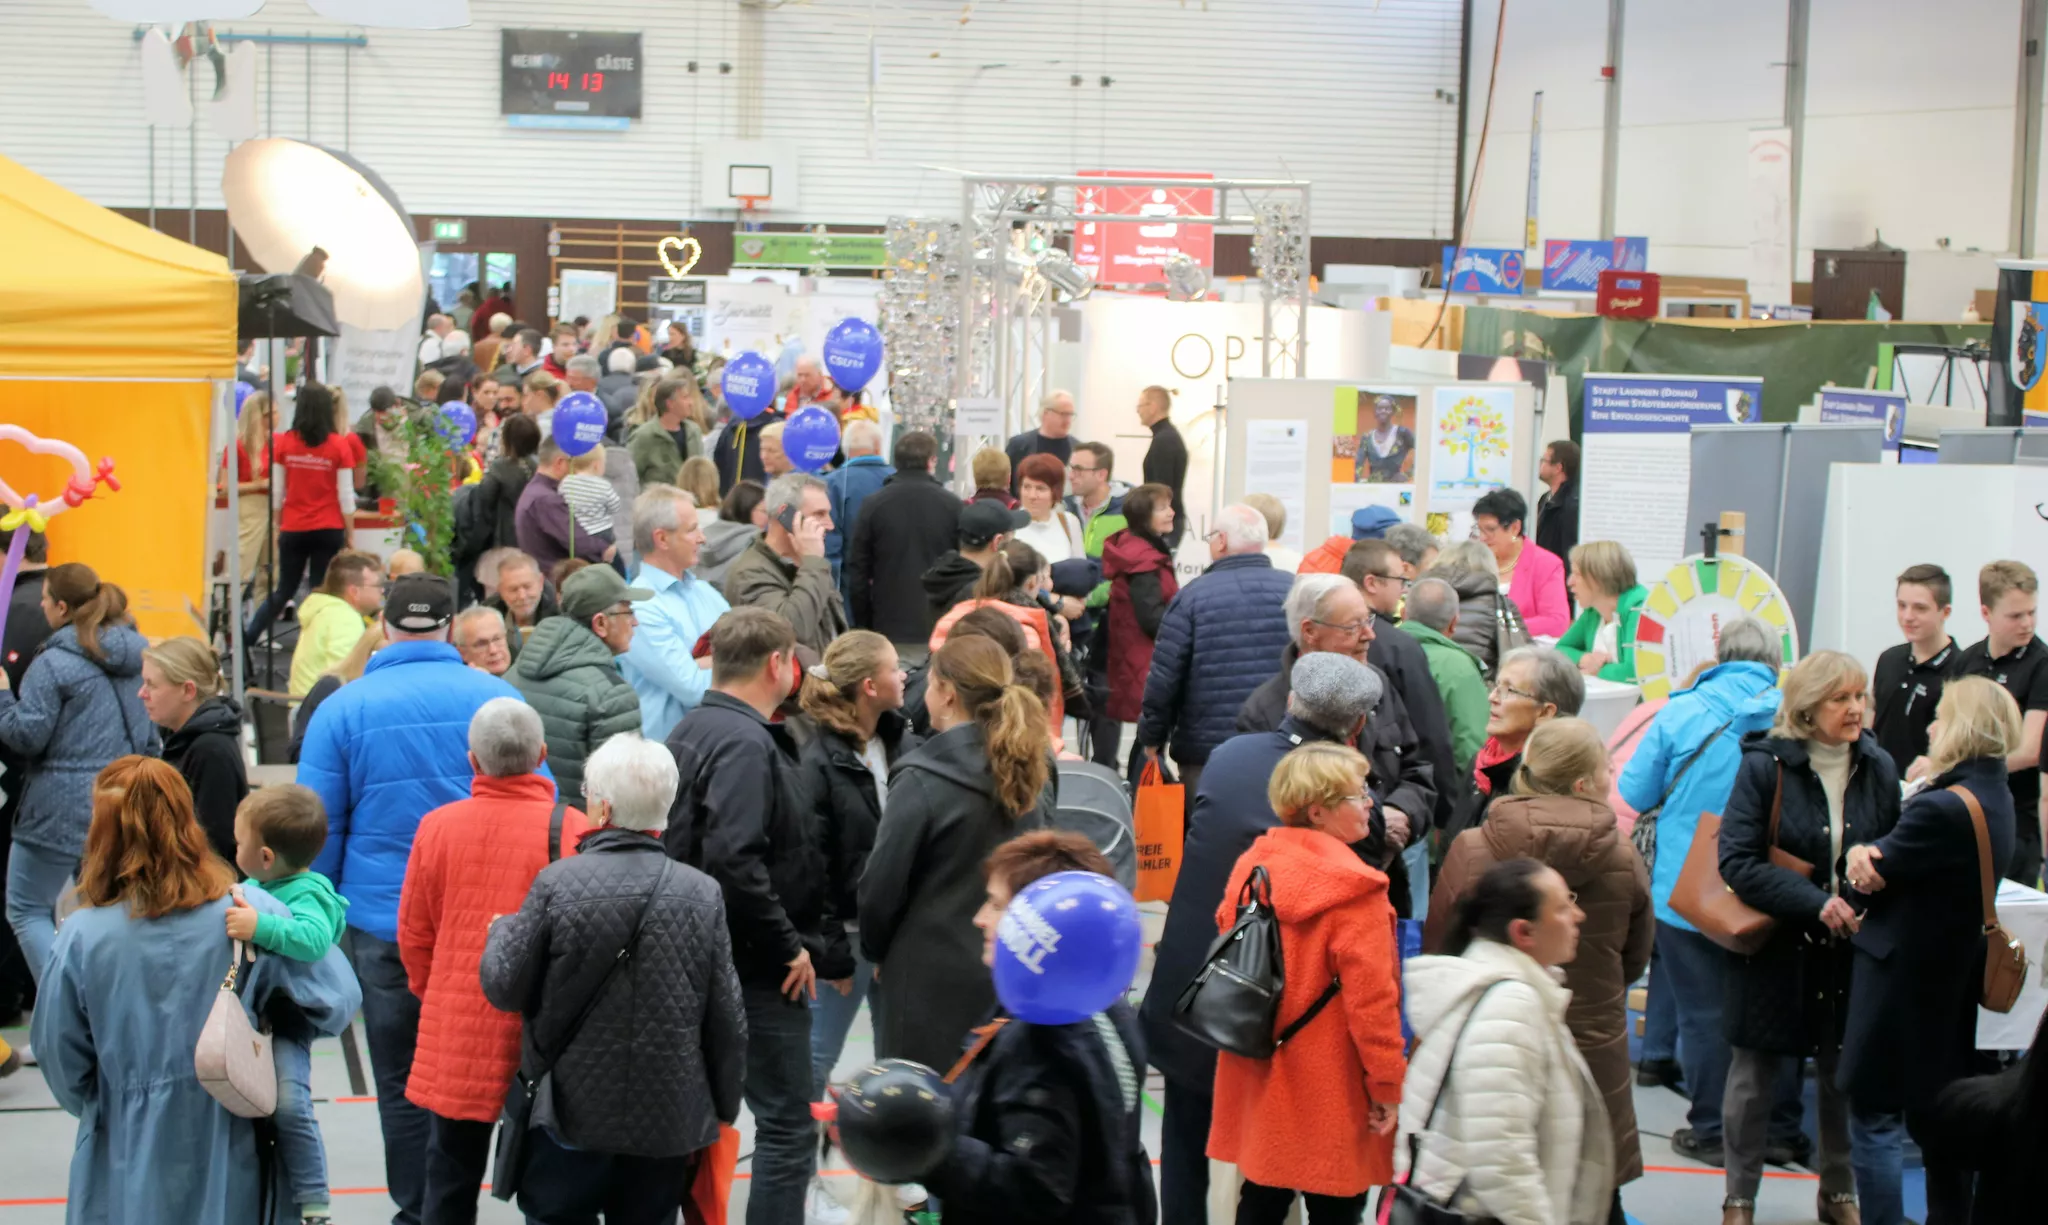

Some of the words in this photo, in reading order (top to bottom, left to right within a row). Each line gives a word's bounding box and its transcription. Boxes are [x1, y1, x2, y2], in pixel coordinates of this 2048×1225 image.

[595, 53, 635, 71] GÄSTE
[547, 71, 570, 91] 14
[581, 72, 604, 92] 13
